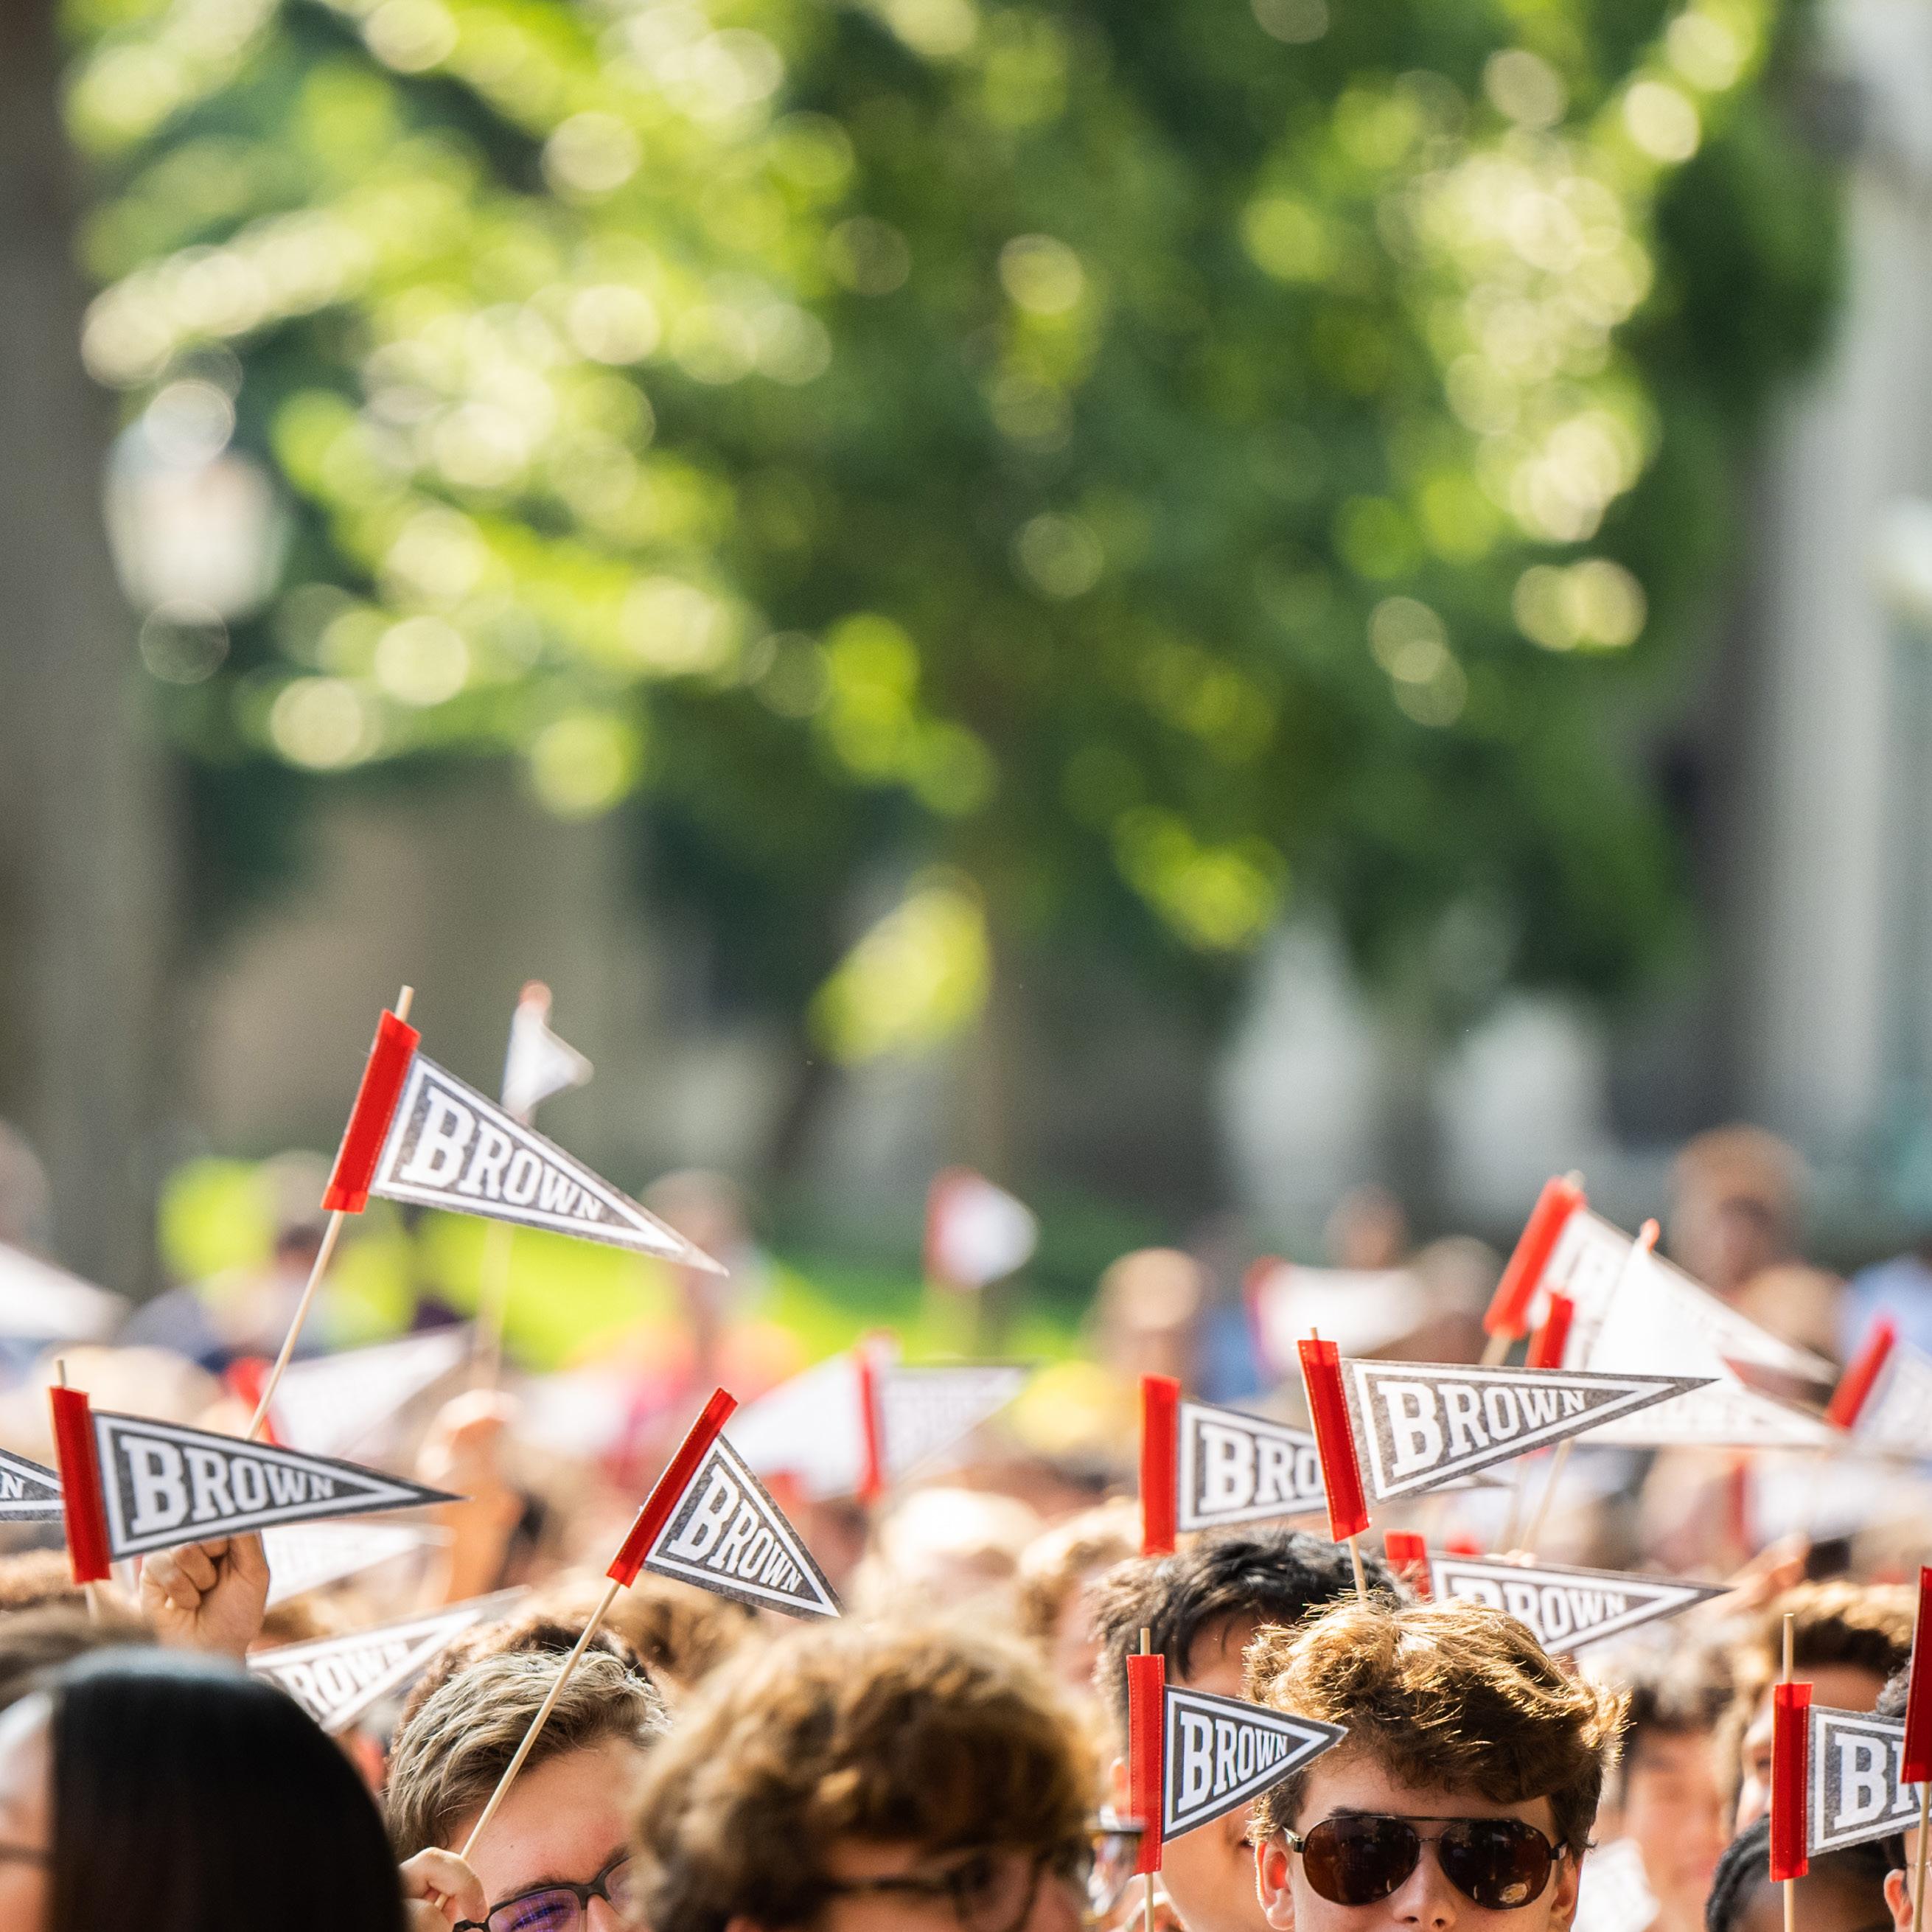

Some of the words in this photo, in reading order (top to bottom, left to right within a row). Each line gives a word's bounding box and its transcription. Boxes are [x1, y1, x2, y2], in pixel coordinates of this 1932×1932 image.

[400, 1085, 603, 1221] BROWN
[1199, 1422, 1324, 1511] BRO
[1375, 1380, 1585, 1478] BROWN
[120, 1434, 336, 1535] BROWN
[666, 1463, 803, 1593] BROWN
[1178, 1711, 1288, 1813] BROWN
